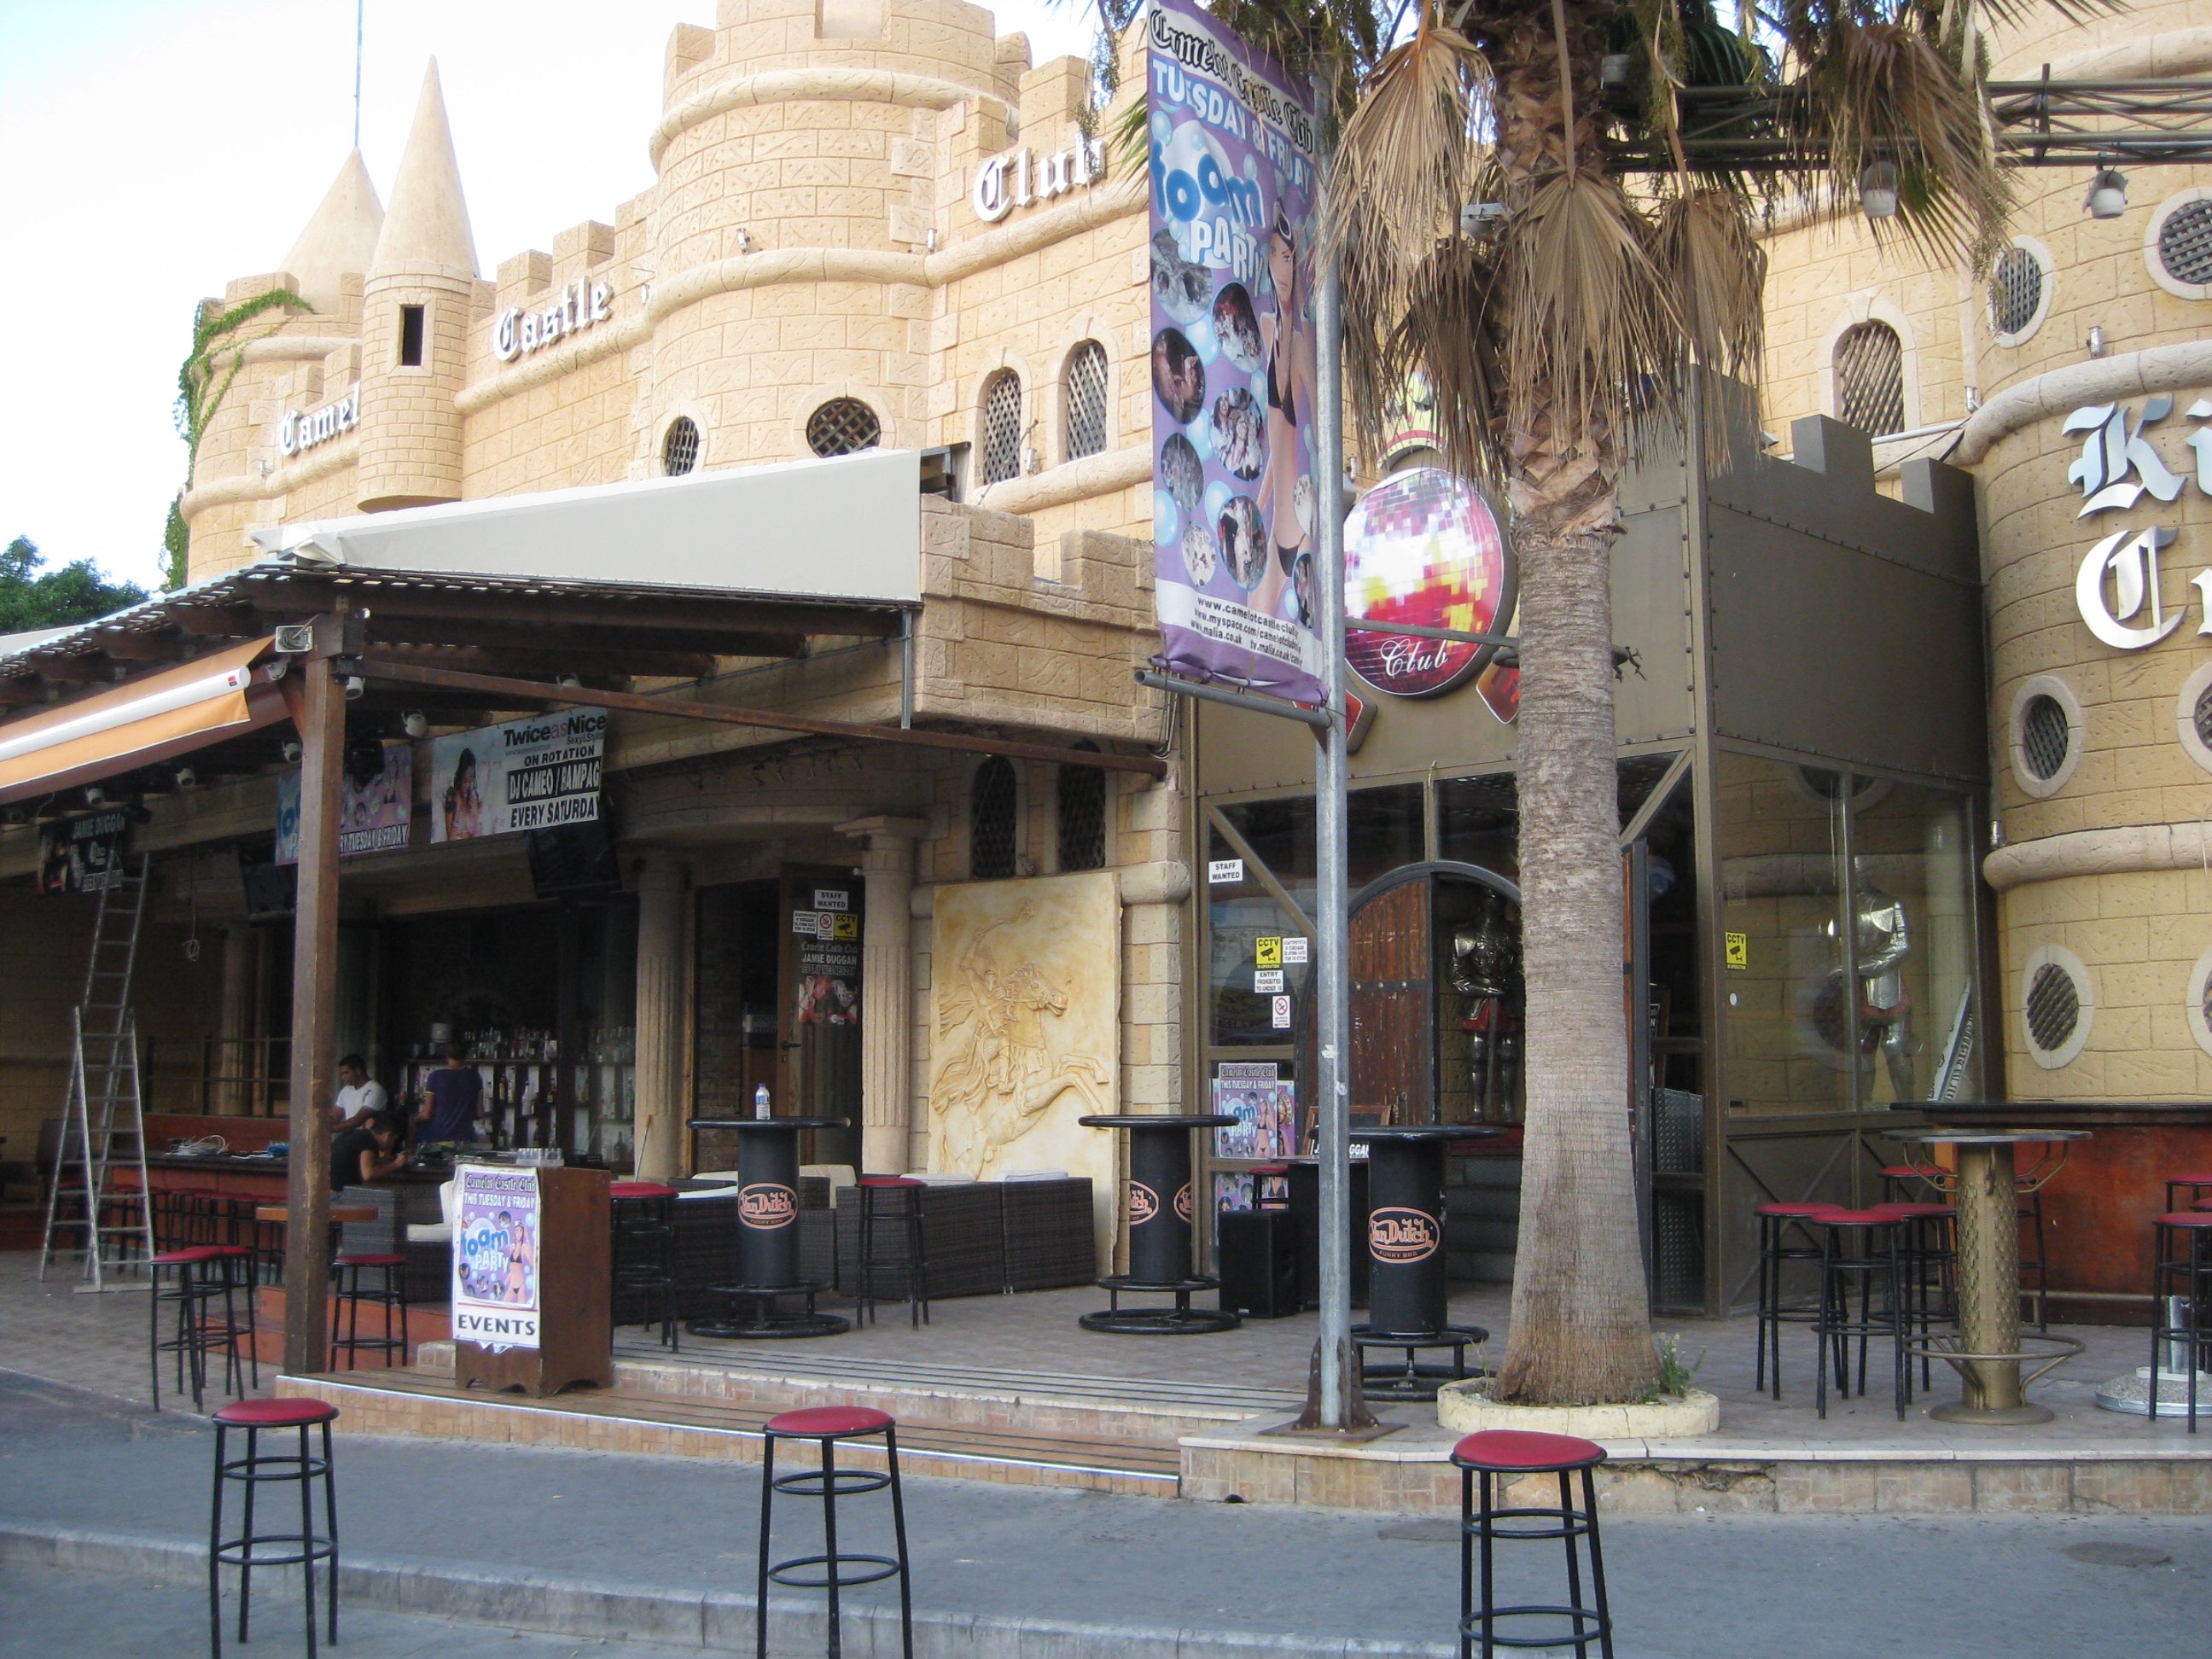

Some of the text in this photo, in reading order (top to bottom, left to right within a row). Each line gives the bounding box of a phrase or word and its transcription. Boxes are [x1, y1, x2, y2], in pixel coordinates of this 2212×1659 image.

[973, 131, 1107, 223] Club
[1190, 217, 1263, 297] PARTY
[492, 276, 614, 362] Castle
[278, 381, 361, 457] Camel
[1380, 638, 1448, 678] Club
[525, 755, 539, 766] ON
[542, 745, 595, 765] ROTATION
[521, 768, 554, 799] CAMEO
[561, 760, 600, 793] RAMPAG
[510, 805, 545, 829] EVERY
[348, 829, 375, 852] TUESDAY
[383, 824, 409, 847] FRIDAY
[1212, 871, 1240, 881] WANTED
[1215, 862, 1236, 870] STAFF
[836, 915, 856, 923] CCTV
[1258, 938, 1279, 947] CCTV
[1726, 934, 1745, 944] CCTV
[802, 953, 857, 965] JAMIE DUGGAN
[1221, 1080, 1231, 1089] THIS
[1231, 1080, 1253, 1089] TUESDAY
[1258, 1080, 1275, 1089] FRIDAY
[464, 1192, 477, 1205] THIS
[479, 1193, 505, 1208] TUESDAY
[513, 1195, 536, 1209] FRIDAY
[474, 1250, 509, 1273] PARTY
[457, 1313, 536, 1336] EVENTS
